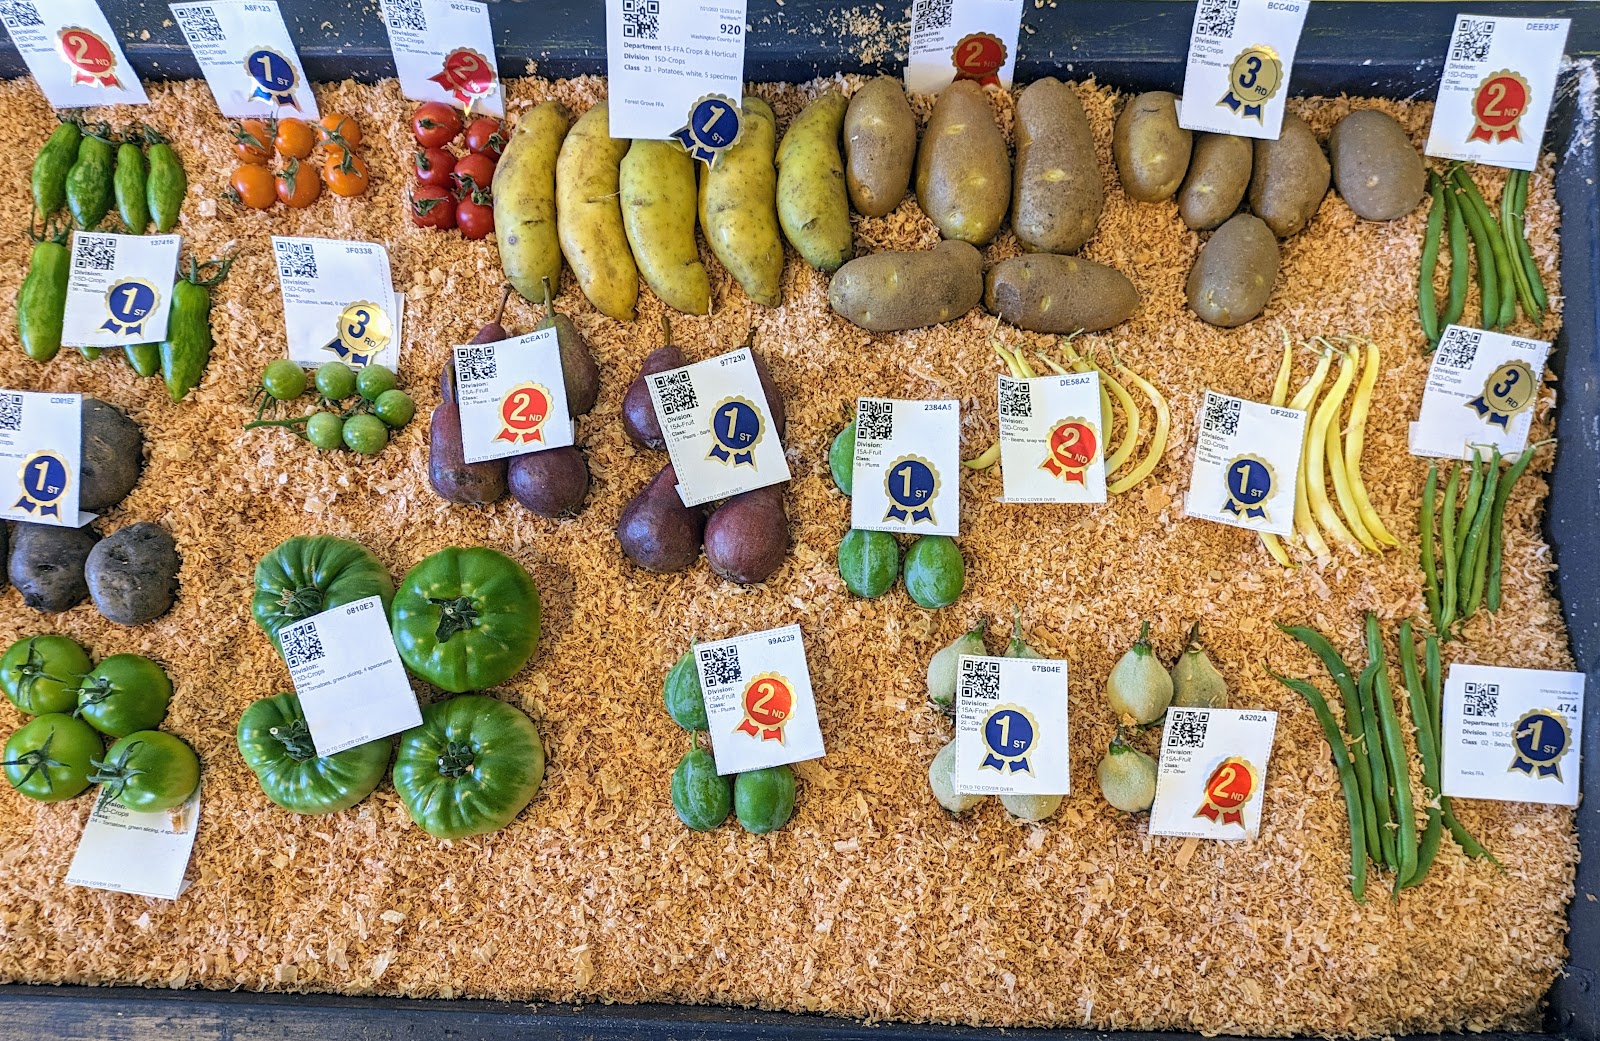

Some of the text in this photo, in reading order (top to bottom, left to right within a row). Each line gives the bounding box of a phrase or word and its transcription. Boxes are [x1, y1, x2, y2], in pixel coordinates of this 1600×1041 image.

[451, 4, 480, 13] 92CFED
[1268, 2, 1299, 12] BCC4D9
[720, 24, 741, 35] 920
[1526, 23, 1560, 31] DEE93F
[914, 31, 940, 39] Division:
[1195, 37, 1220, 46] Division:
[69, 36, 109, 66] 2 ND
[624, 42, 662, 51] Department
[664, 45, 684, 53] 15-FFA
[686, 47, 703, 56] Crops
[712, 50, 737, 59] Horticult
[964, 42, 983, 66] 2
[1194, 45, 1223, 54] 15D-Crops
[624, 53, 685, 64] Division 15D-Crops
[257, 55, 289, 86] 1 ST
[451, 56, 480, 92] 2 ND
[658, 67, 684, 76] Potatoes,
[710, 73, 737, 81] specimen
[1239, 57, 1267, 96] 3 RD
[1483, 84, 1506, 116] 2
[702, 105, 725, 144] 1 ST
[122, 287, 138, 314] 1
[348, 310, 376, 347] 3 RD
[520, 333, 550, 344] ACEA1D
[1511, 340, 1536, 350] 85E753
[720, 354, 746, 366] 977230
[1434, 367, 1459, 376] Division:
[1060, 378, 1090, 386] DE58A2
[1493, 369, 1519, 408] 3 RD
[510, 393, 542, 422] 2 ND
[1271, 409, 1299, 419] DF22D2
[667, 414, 692, 423] Division:
[724, 408, 752, 441] 1 ST
[670, 420, 695, 431] 15A-Fruit
[1202, 431, 1226, 442] Division:
[1057, 428, 1088, 464] 2 ND
[1201, 438, 1228, 450] 15D-Crops
[34, 461, 60, 494] 1 ST
[898, 466, 927, 498] 1 ST
[1237, 465, 1263, 497] 1 ST
[347, 602, 374, 615] 0810E3
[768, 635, 794, 645] 99A239
[291, 663, 318, 676] Division:
[294, 669, 325, 683] 15D-Crops
[308, 681, 332, 691] Tomatoes,
[333, 675, 346, 683] green
[347, 669, 363, 678] slicing,
[708, 687, 734, 695] Division:
[709, 693, 735, 702] 15A-Fruit
[752, 683, 785, 718] 2 ND
[1557, 704, 1577, 713] 474
[1463, 719, 1499, 727] Department
[996, 715, 1026, 748] 1 ST
[1528, 720, 1556, 754] 1 ST
[1213, 767, 1244, 801] 2 ND
